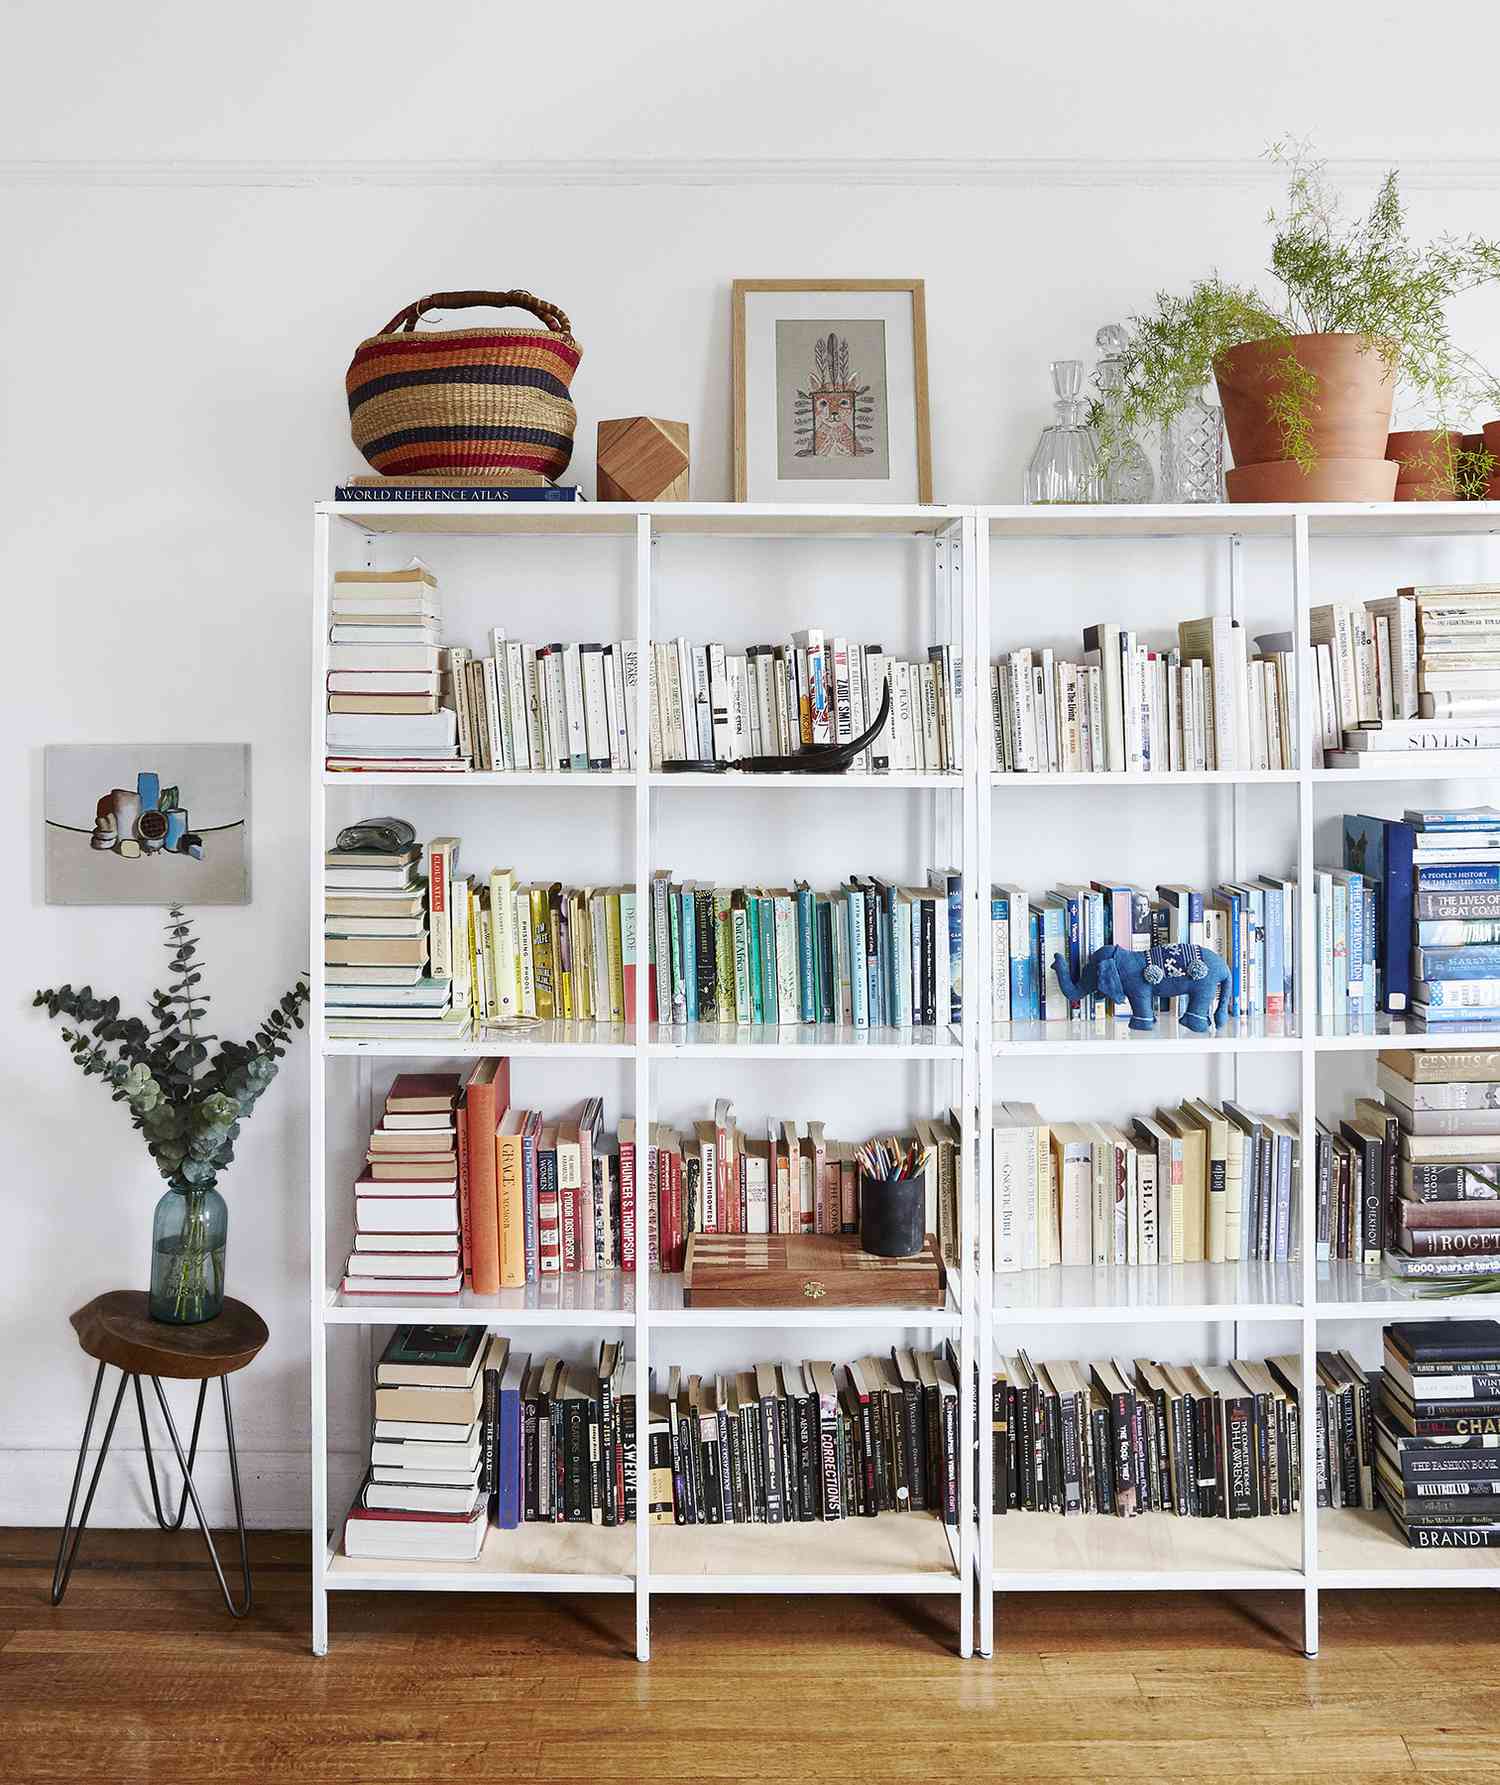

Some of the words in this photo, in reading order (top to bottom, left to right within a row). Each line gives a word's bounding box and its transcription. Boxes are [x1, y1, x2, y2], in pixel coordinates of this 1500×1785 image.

[342, 488, 391, 502] WORLD
[393, 488, 466, 502] REFERENCE
[470, 488, 510, 502] ATLAS
[836, 651, 847, 666] NW
[836, 679, 850, 702] ZADIE
[1067, 682, 1076, 692] We
[1067, 692, 1077, 703] The
[899, 688, 909, 720] PLATO
[838, 706, 851, 736] SMITH
[1408, 734, 1478, 749] STYLIST
[433, 854, 443, 883] CLOUD
[1428, 871, 1457, 879] PEOPLE'S
[433, 883, 444, 911] ATLAS
[1439, 896, 1458, 906] THE
[1459, 895, 1486, 906] LIVES
[1352, 900, 1364, 926] FOOD
[1439, 906, 1469, 917] GREAT
[735, 944, 746, 972] Africa
[994, 922, 1008, 966] DOROTHY
[1353, 926, 1365, 981] REVOLUTION
[995, 966, 1008, 1001] PARKER
[501, 1143, 515, 1187] GRACE
[705, 1148, 714, 1162] THE
[540, 1158, 548, 1191] WOMEN
[621, 1161, 634, 1199] HUNTER
[1423, 1165, 1431, 1200] HAROLD
[1430, 1165, 1439, 1200] BLOOM
[563, 1191, 574, 1218] FYODOR
[705, 1163, 714, 1224] FLAMETHROWERS
[829, 1181, 839, 1200] THE
[1002, 1210, 1014, 1239] BIBLE
[1142, 1179, 1154, 1246] BLAKE
[1366, 1195, 1380, 1246] CHEKHOV
[564, 1218, 576, 1261] DOSTOEVSKY
[622, 1209, 636, 1262] THOMPSON
[1407, 1264, 1435, 1273] 5000
[1436, 1263, 1462, 1274] years
[1463, 1262, 1474, 1272] of
[602, 1393, 611, 1422] FINDING
[486, 1421, 494, 1441] THE
[603, 1424, 611, 1446] JESUS
[800, 1417, 810, 1443] AENEID
[1119, 1424, 1128, 1440] THE
[1240, 1421, 1249, 1432] THE
[1456, 1418, 1500, 1435] CHA
[486, 1444, 494, 1471] ROAD
[1022, 1434, 1031, 1465] Universe
[1241, 1433, 1250, 1465] COMPLETE
[623, 1442, 637, 1492] SWERVE
[821, 1433, 841, 1511] CORRECTIONS
[1231, 1440, 1245, 1498] LAWRENCE
[1242, 1466, 1250, 1486] POEMS
[1411, 1461, 1431, 1471] THE
[1432, 1460, 1470, 1471] FASHION
[1471, 1459, 1498, 1470] BOOK
[1418, 1530, 1489, 1546] BRANDT
